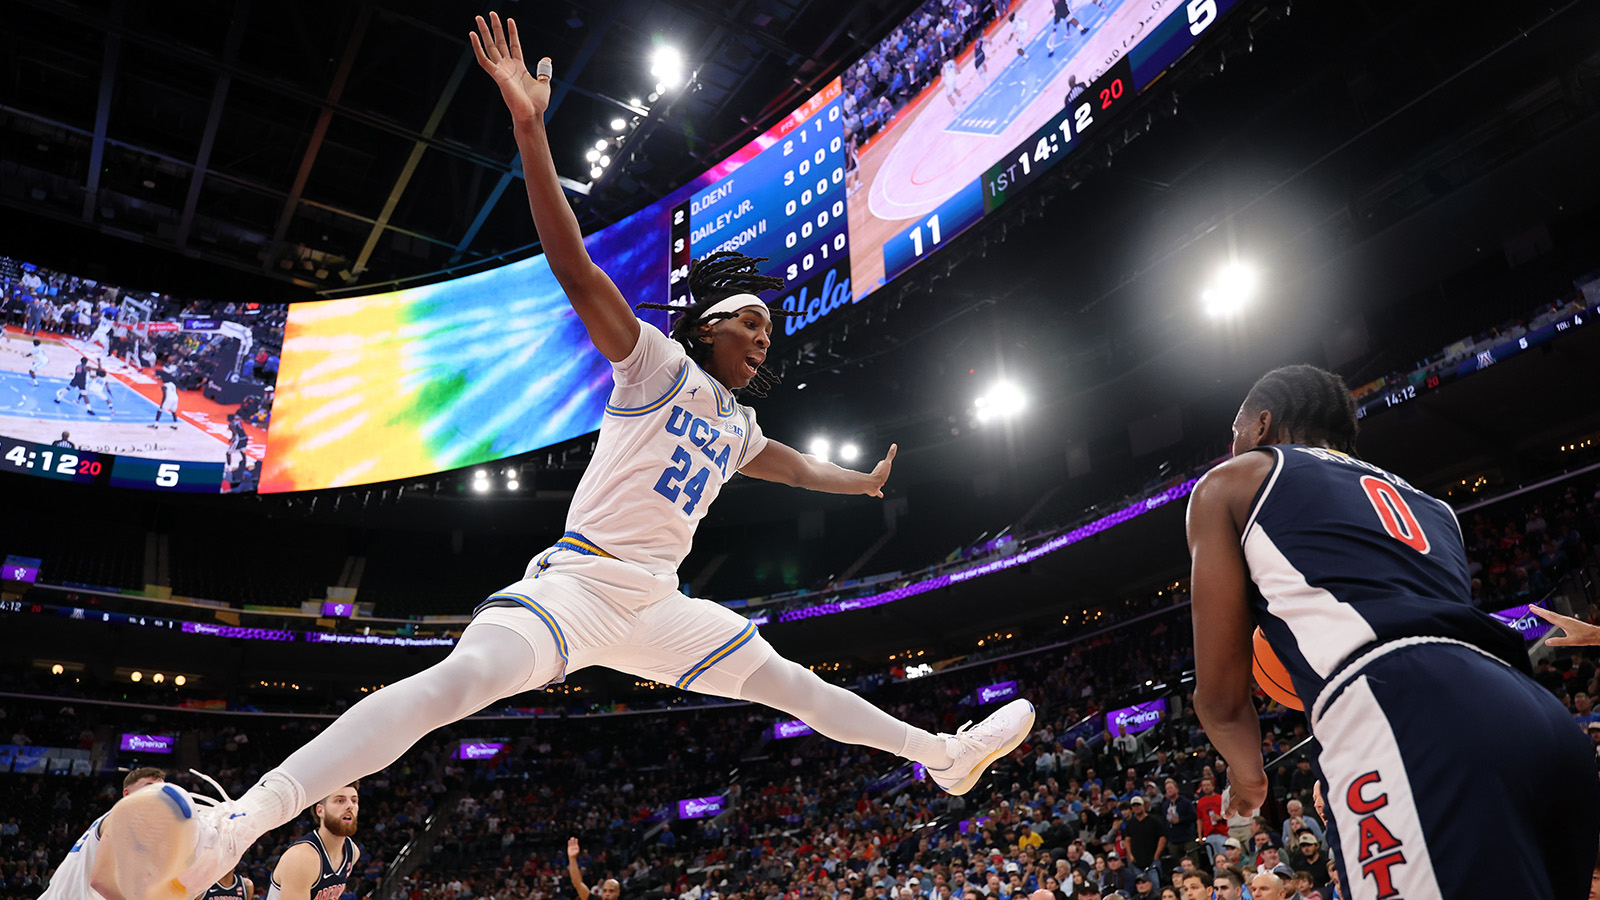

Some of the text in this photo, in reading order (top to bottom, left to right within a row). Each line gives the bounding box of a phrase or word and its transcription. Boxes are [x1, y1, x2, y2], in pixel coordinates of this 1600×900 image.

[1186, 0, 1217, 36] 5
[1099, 78, 1124, 110] 20
[674, 105, 840, 225] 2 D.DENT 2 1 1 0
[988, 101, 1094, 197] 1ST 14:12
[674, 136, 842, 254] 3 DAILEY JR. 3 0 0 0
[670, 264, 689, 285] 24
[698, 224, 757, 263] AMERSON
[785, 199, 797, 217] 0
[801, 189, 812, 206] 0
[816, 178, 828, 195] 0
[831, 166, 843, 184] 0
[785, 231, 797, 249] 0
[801, 221, 813, 238] 0
[817, 210, 829, 228] 0
[832, 200, 844, 218] 0
[908, 213, 942, 257] 11
[786, 232, 846, 281] 3 0 1 0
[1384, 385, 1416, 407] 14:12
[1426, 376, 1439, 389] 20
[0, 442, 102, 476] 4:12 20
[665, 405, 731, 480] UCLA
[155, 463, 181, 488] 5
[653, 445, 711, 516] 24
[1359, 474, 1431, 555] 0
